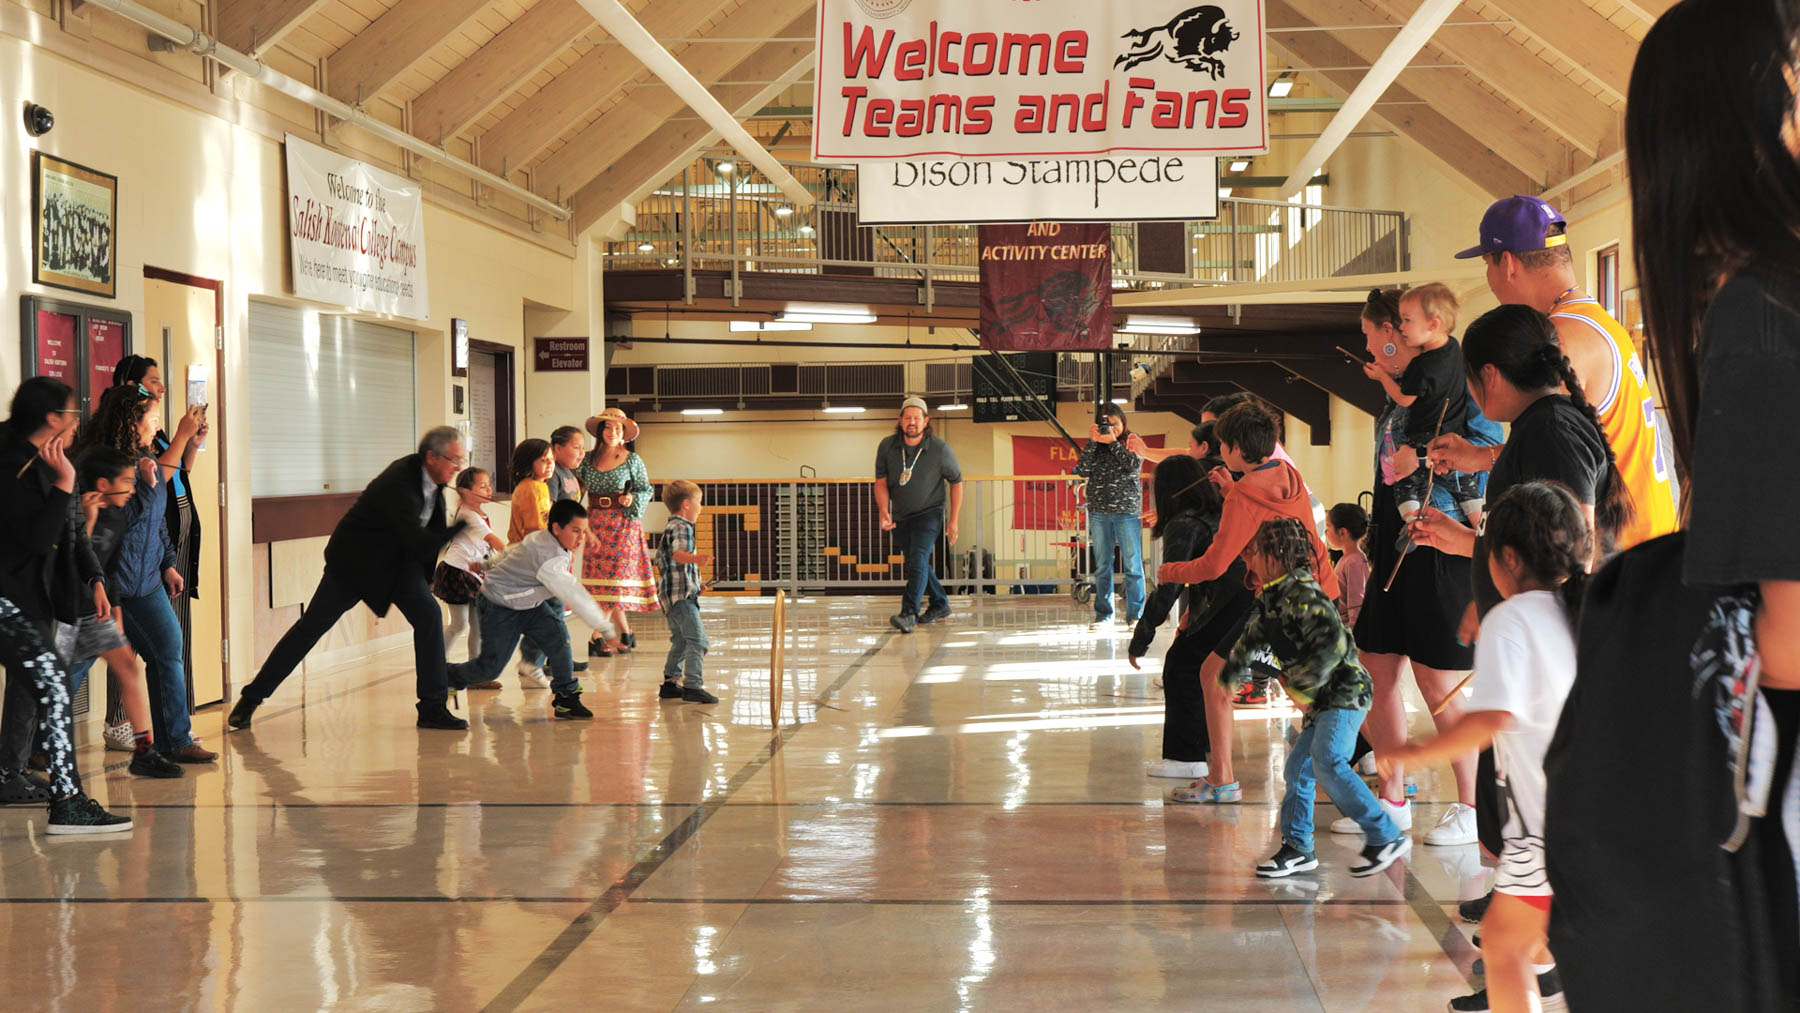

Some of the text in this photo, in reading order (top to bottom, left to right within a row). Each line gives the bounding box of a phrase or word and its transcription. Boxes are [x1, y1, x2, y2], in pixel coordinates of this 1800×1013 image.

[843, 20, 1088, 81] Welcome
[841, 77, 1252, 137] Teams and Fans
[327, 172, 386, 214] Welcome to the
[292, 195, 417, 276] Salish Kootenai College Campus
[1027, 222, 1061, 237] AND
[981, 243, 1108, 261] ACTIVITY CENTER
[549, 341, 585, 351] Restroom
[551, 358, 583, 369] Elevator
